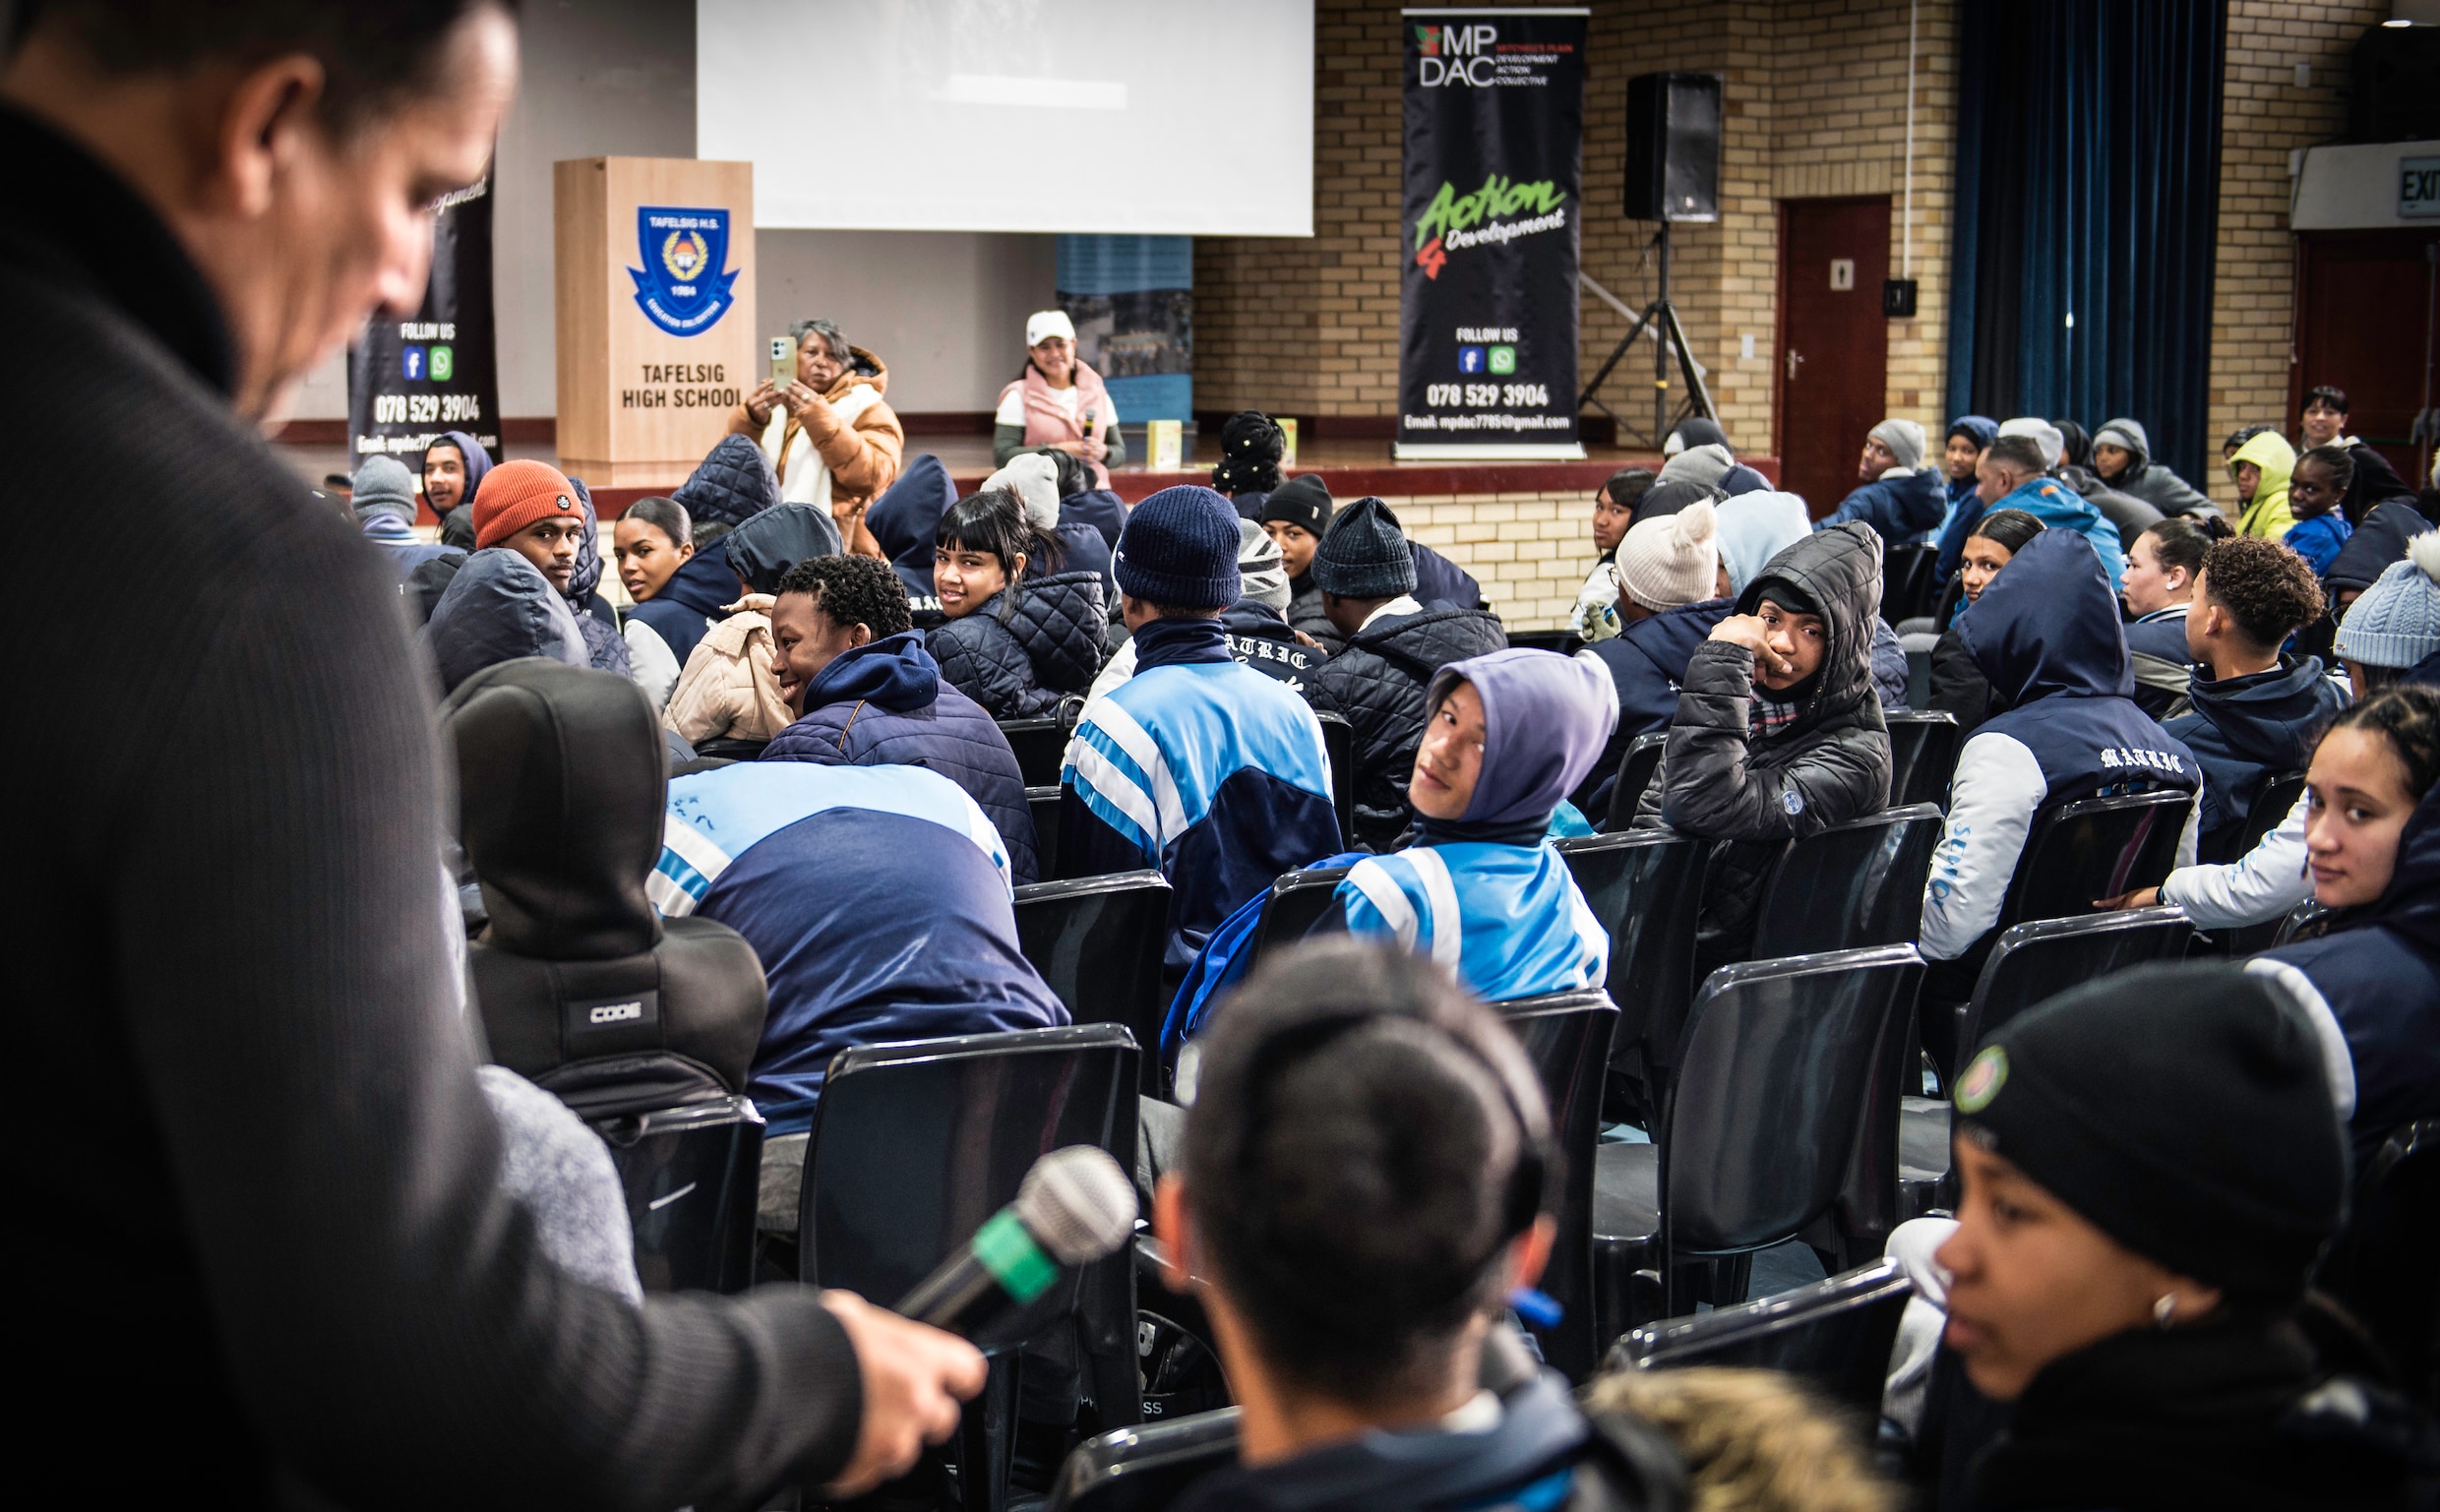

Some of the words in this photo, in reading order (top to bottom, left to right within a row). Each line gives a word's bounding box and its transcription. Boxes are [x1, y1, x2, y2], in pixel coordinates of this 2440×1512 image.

[1442, 25, 1497, 56] MP
[1494, 54, 1559, 65] DEVELOPMENT
[1420, 56, 1495, 88] DAC
[1494, 66, 1532, 76] ACTION
[1494, 76, 1550, 87] COLLECTIVE
[1415, 172, 1567, 252] Action
[649, 216, 699, 229] TAFELSIG
[1415, 236, 1447, 280] 4
[1444, 208, 1565, 251] Development
[400, 323, 439, 340] FOLLOW
[440, 323, 456, 340] US
[1456, 328, 1500, 342] FOLLOW
[1502, 328, 1518, 342] US
[642, 364, 724, 384] TAFELSIG
[623, 390, 666, 408] HIGH
[1427, 385, 1461, 406] 078
[1465, 385, 1499, 406] 529
[1502, 385, 1549, 406] 3904
[375, 395, 407, 423] 078
[409, 395, 439, 423] 529
[442, 394, 480, 421] 3904
[1404, 414, 1437, 430] Email:
[1224, 633, 1312, 670] ATRIC
[2101, 748, 2184, 774] MATRIC
[590, 1001, 641, 1024] CODE
